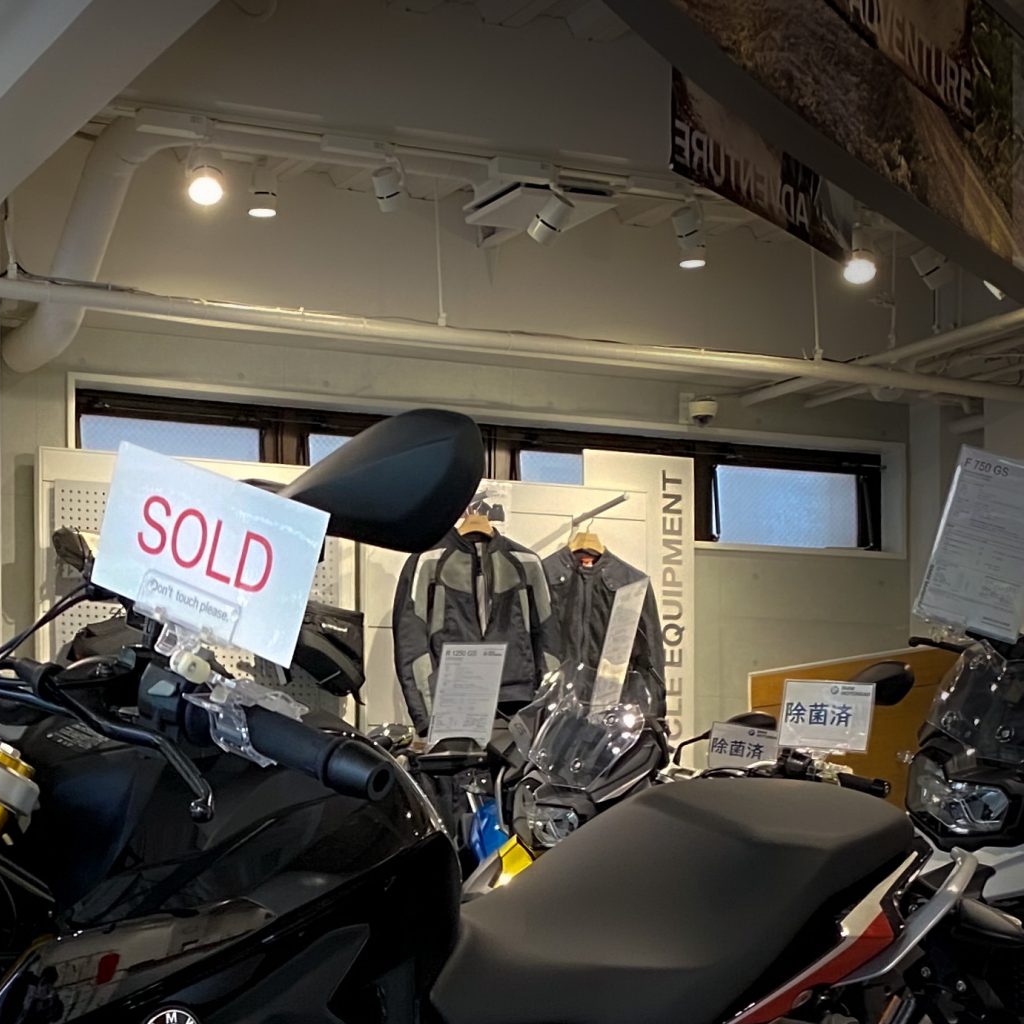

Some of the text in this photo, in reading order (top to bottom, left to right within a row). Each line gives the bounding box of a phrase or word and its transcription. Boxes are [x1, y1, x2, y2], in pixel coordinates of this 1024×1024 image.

[964, 457, 1010, 477] F 750 GS
[137, 495, 274, 593] SOLD
[662, 469, 684, 667] EQUIPMENT
[148, 579, 174, 598] Don't
[175, 590, 199, 611] touch
[784, 702, 853, 727] 除菌済
[711, 737, 765, 760] 除菌済
